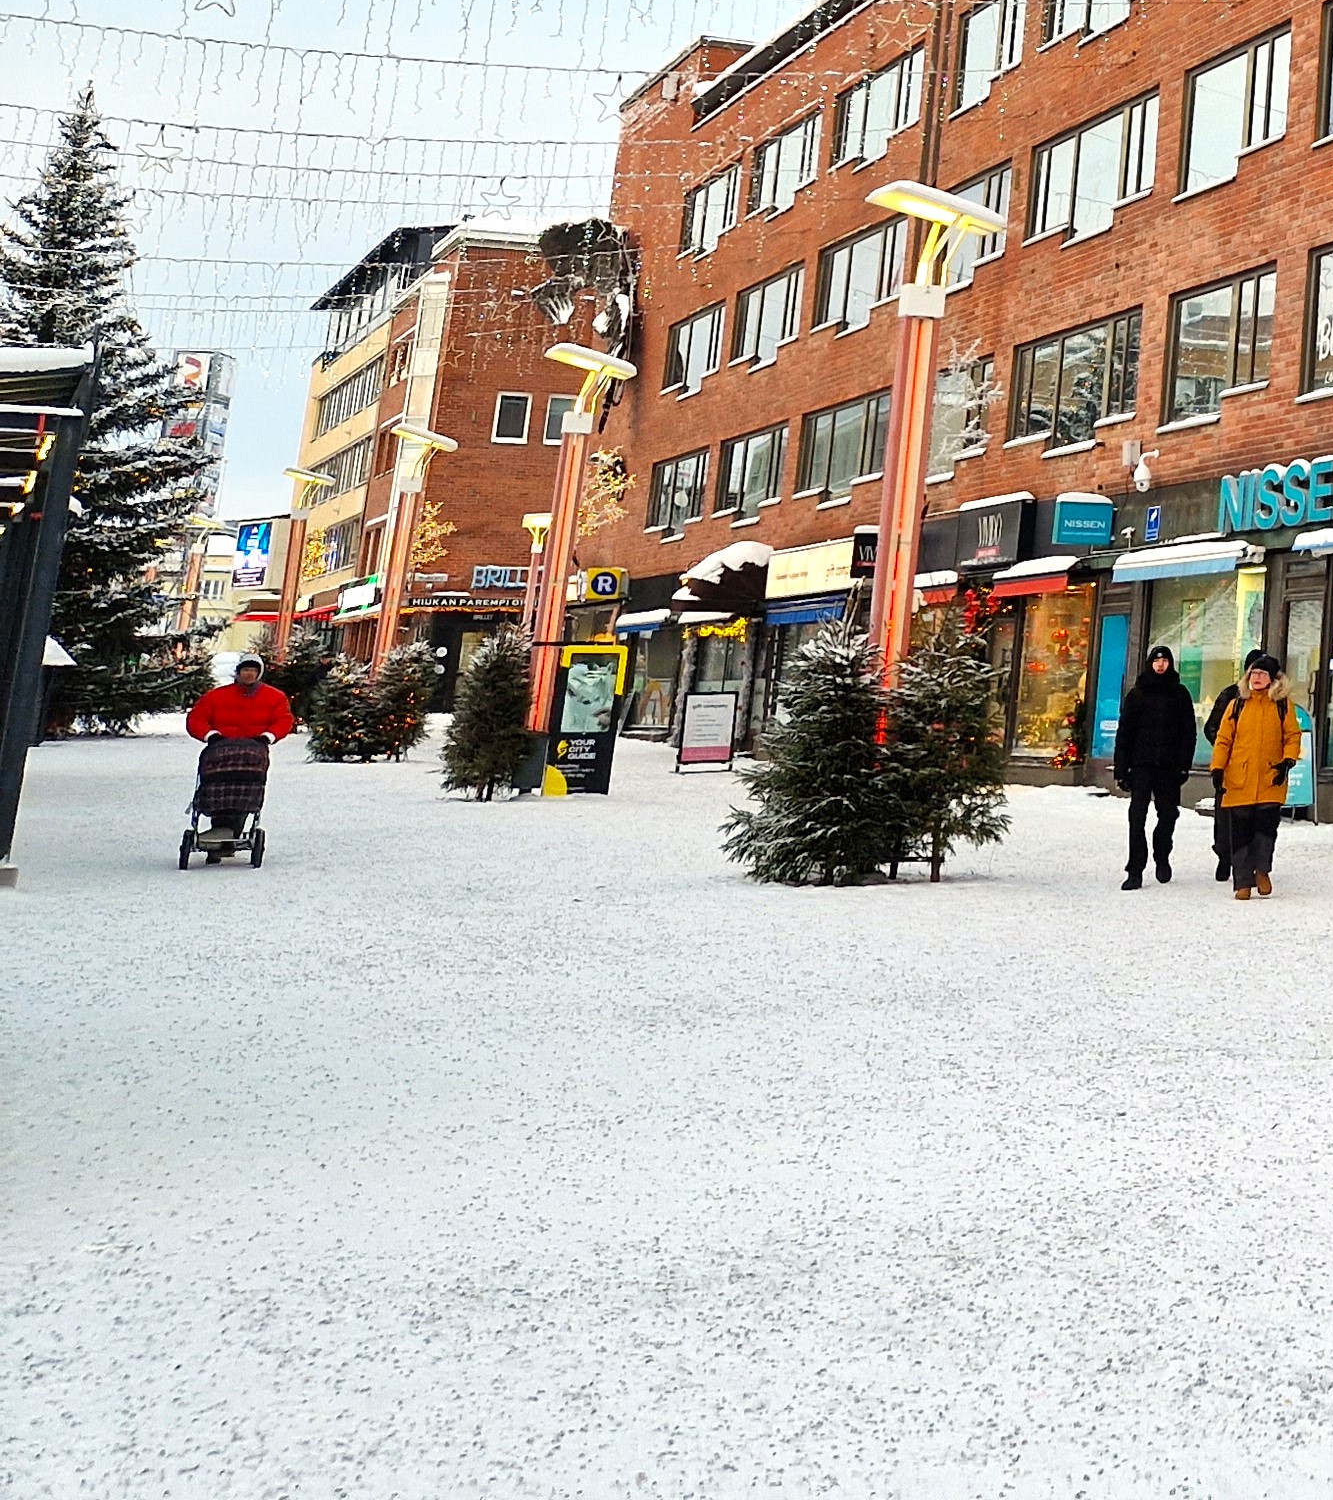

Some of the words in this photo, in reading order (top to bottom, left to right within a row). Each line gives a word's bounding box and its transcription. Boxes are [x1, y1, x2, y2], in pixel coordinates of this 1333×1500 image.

[1064, 519, 1106, 529] NISSEN
[412, 598, 457, 606] HIUKAN
[459, 598, 510, 606] PAREMPI
